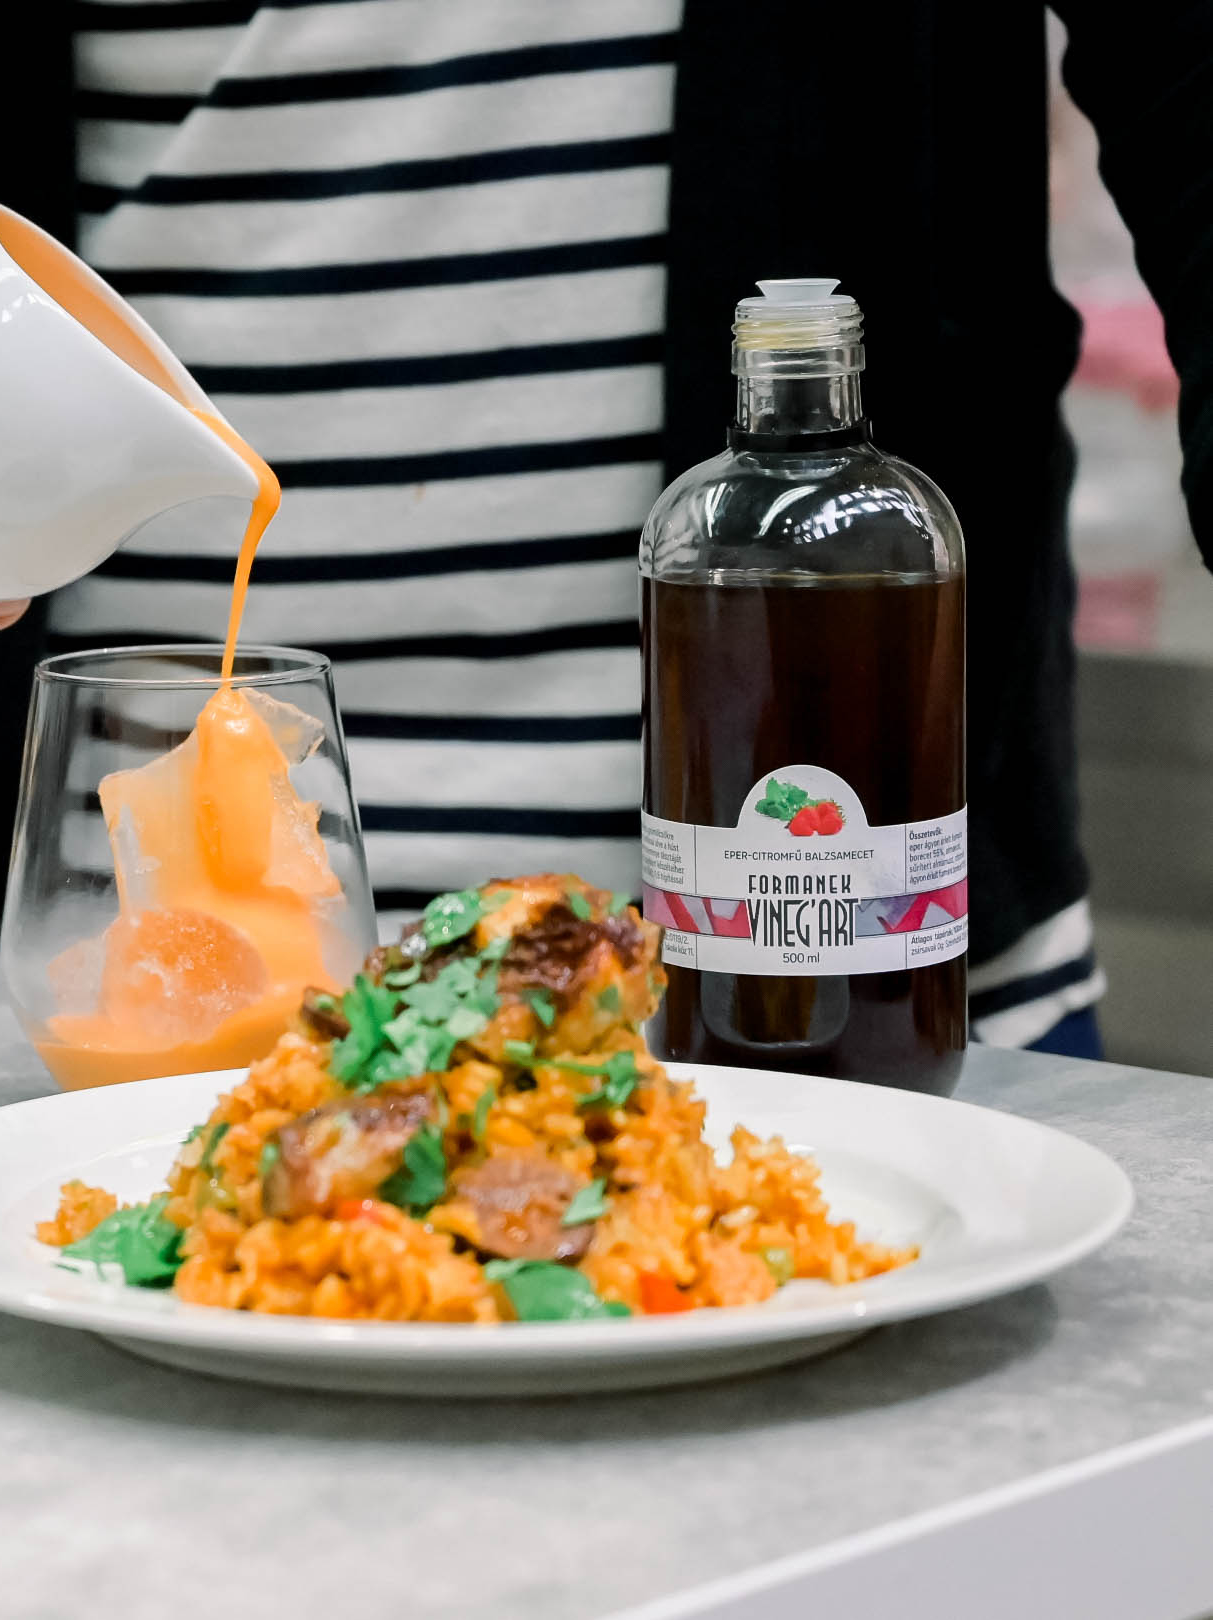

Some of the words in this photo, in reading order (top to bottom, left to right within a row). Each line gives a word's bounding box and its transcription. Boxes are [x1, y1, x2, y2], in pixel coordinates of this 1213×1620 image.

[909, 842, 923, 852] eper
[724, 849, 802, 861] EPER-CITROMFŰ
[805, 849, 875, 861] BALZSAMECET
[748, 874, 851, 894] FORMANEK
[783, 953, 805, 964] 500
[807, 952, 820, 963] ml
